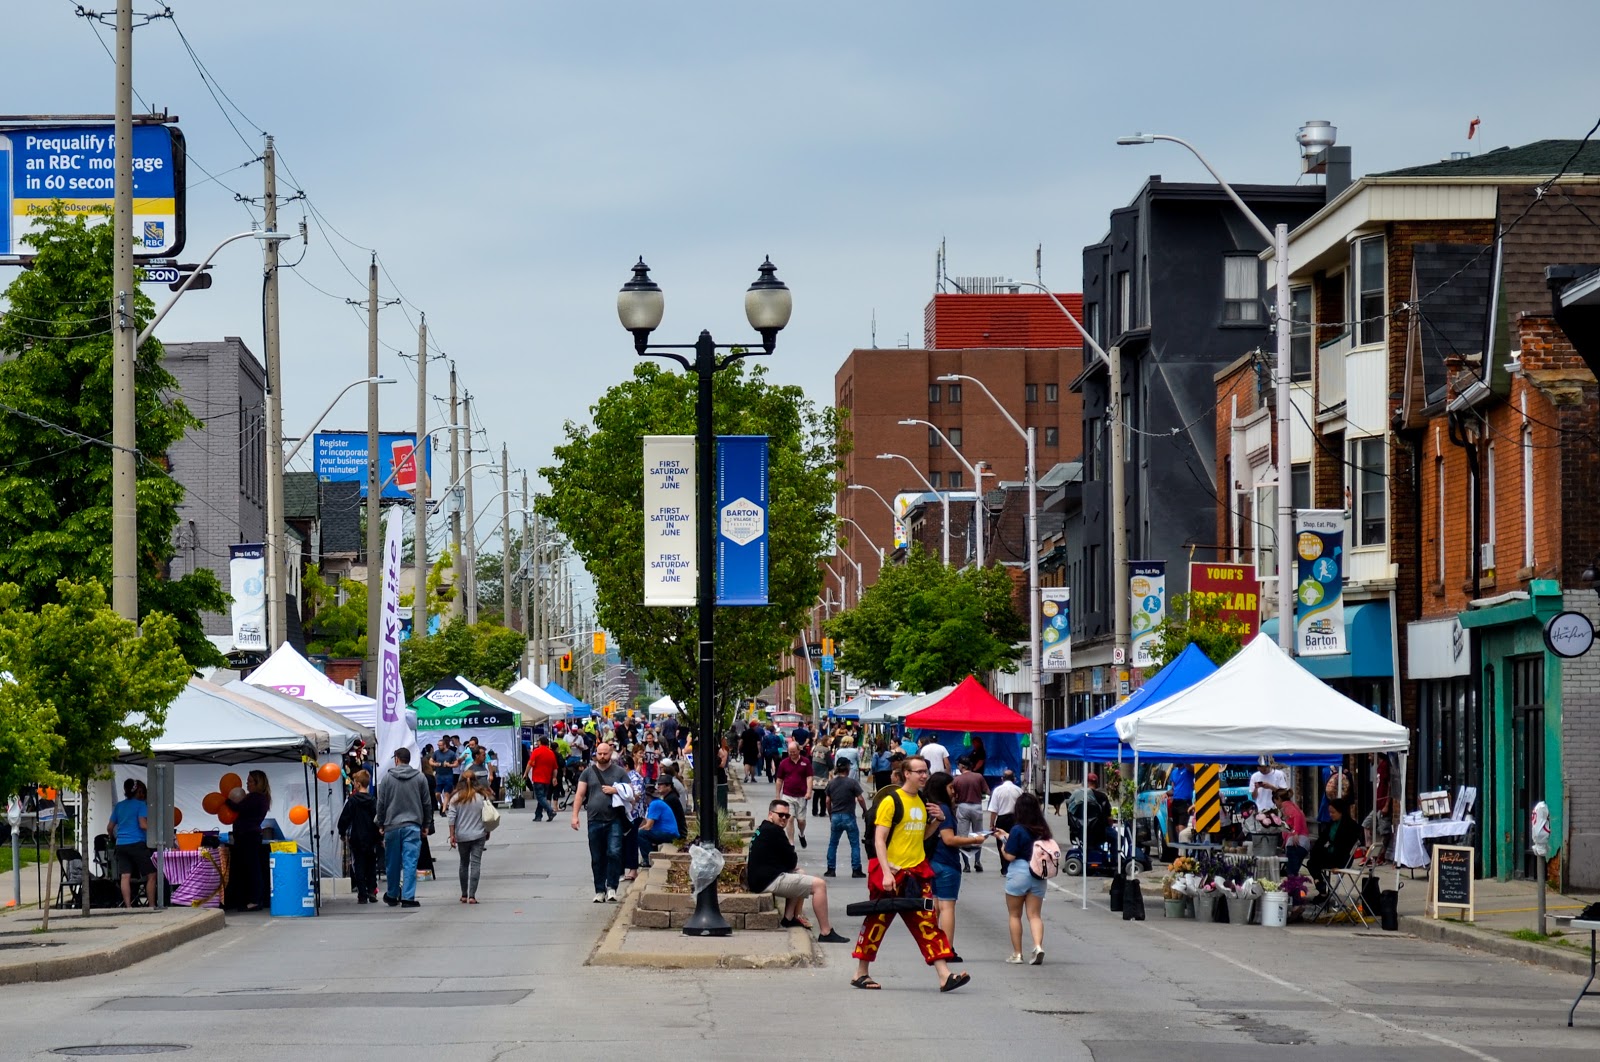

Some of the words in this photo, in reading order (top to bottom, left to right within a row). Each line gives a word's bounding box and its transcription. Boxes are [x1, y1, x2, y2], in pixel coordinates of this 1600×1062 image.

[26, 135, 105, 153] Prequalify
[26, 158, 45, 170] an
[26, 175, 40, 189] in
[44, 175, 65, 189] 60
[69, 176, 139, 189] secon.
[320, 439, 349, 449] Register
[329, 449, 368, 459] incorporate
[320, 458, 335, 466] your
[337, 457, 368, 465] business
[328, 466, 358, 474] minutes!
[726, 509, 759, 517] BARTON
[1303, 521, 1316, 529] Shop.
[1207, 567, 1244, 580] YOUR'S
[239, 632, 261, 641] Barton
[1305, 635, 1338, 646] Barton
[1047, 659, 1067, 667] Barton
[431, 690, 463, 699] Emerald
[444, 717, 479, 726] COFFEE
[483, 716, 500, 724] CO.
